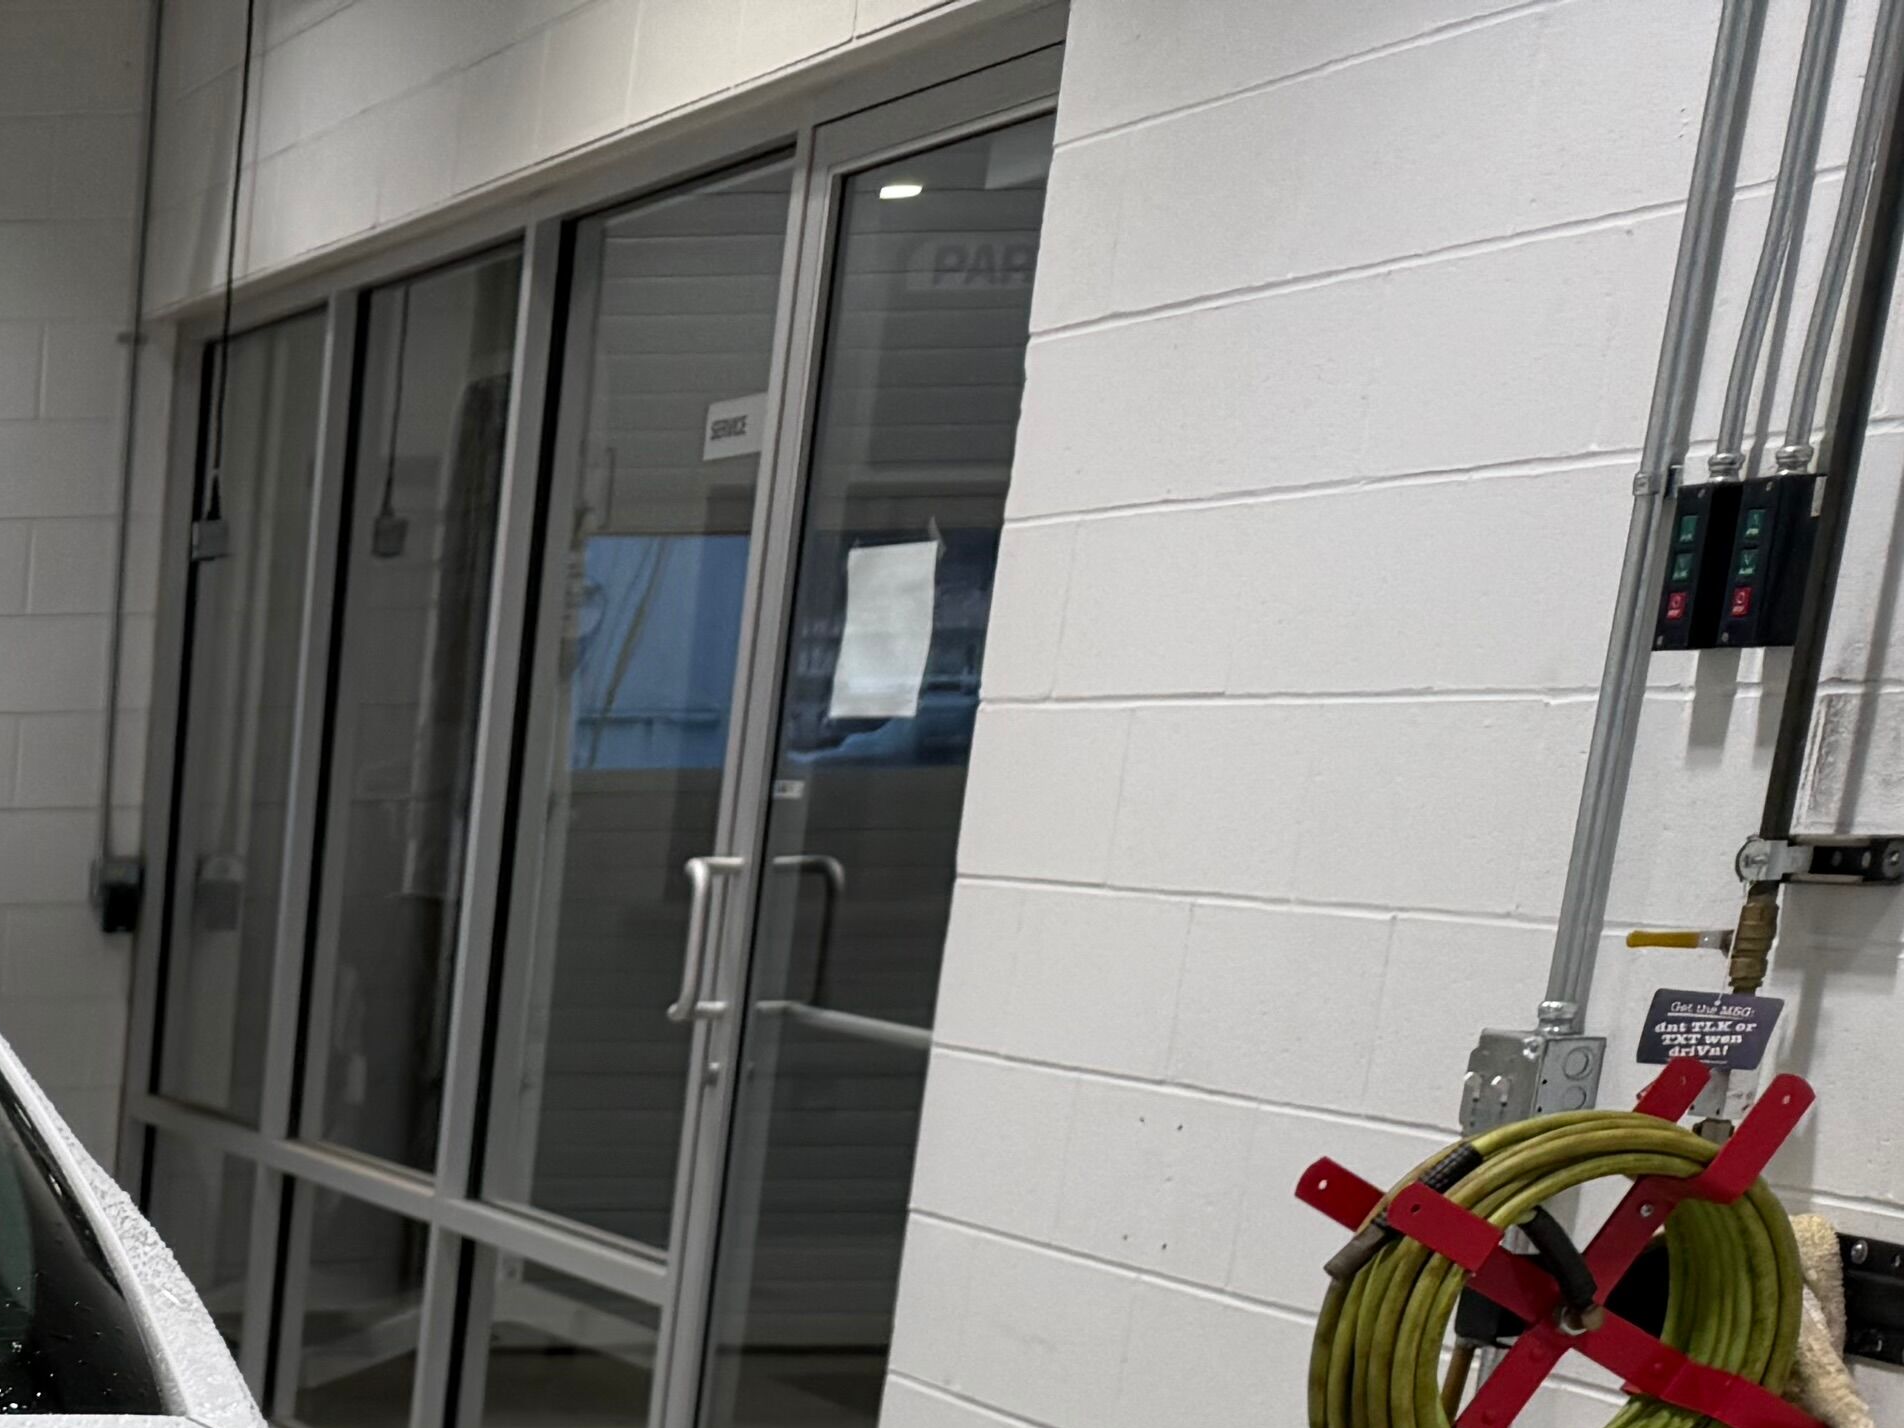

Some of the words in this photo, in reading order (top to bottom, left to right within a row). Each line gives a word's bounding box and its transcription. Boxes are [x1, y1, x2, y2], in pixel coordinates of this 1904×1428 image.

[710, 414, 748, 440] SERVICE
[1670, 1001, 1692, 1012] Get
[1696, 1004, 1718, 1014] the
[1654, 1021, 1687, 1032] dnt
[1691, 1021, 1733, 1032] TLK
[1735, 1023, 1758, 1032] or
[1661, 1034, 1701, 1045] TXT
[1704, 1034, 1743, 1044] wen
